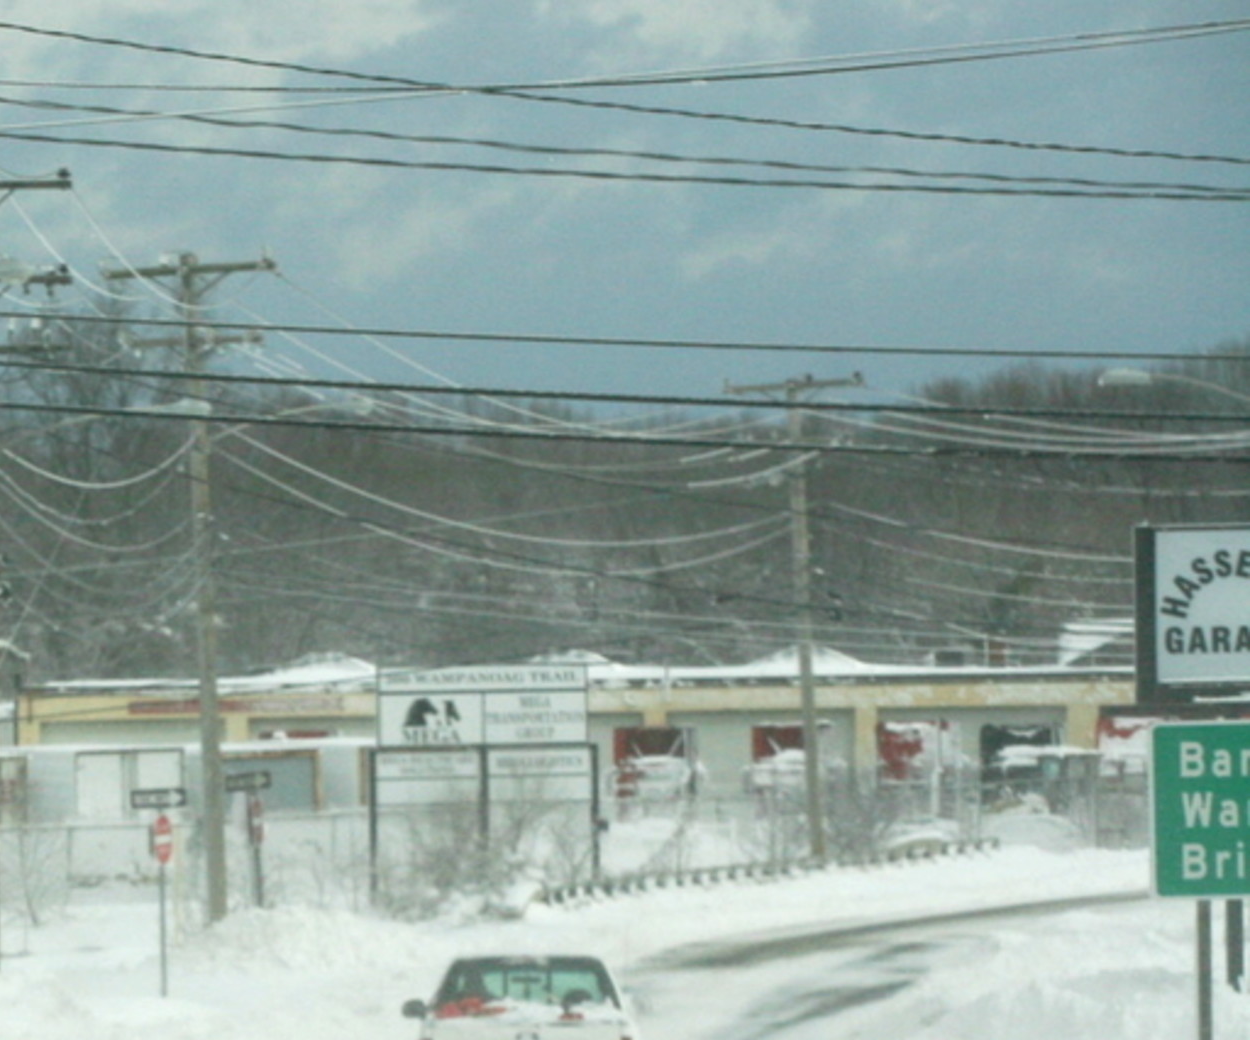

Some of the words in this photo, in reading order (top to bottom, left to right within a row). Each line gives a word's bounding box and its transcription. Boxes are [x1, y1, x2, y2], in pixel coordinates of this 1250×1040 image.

[531, 670, 577, 683] TRAIL
[401, 729, 462, 744] MEGA
[1182, 841, 1246, 880] Bri
